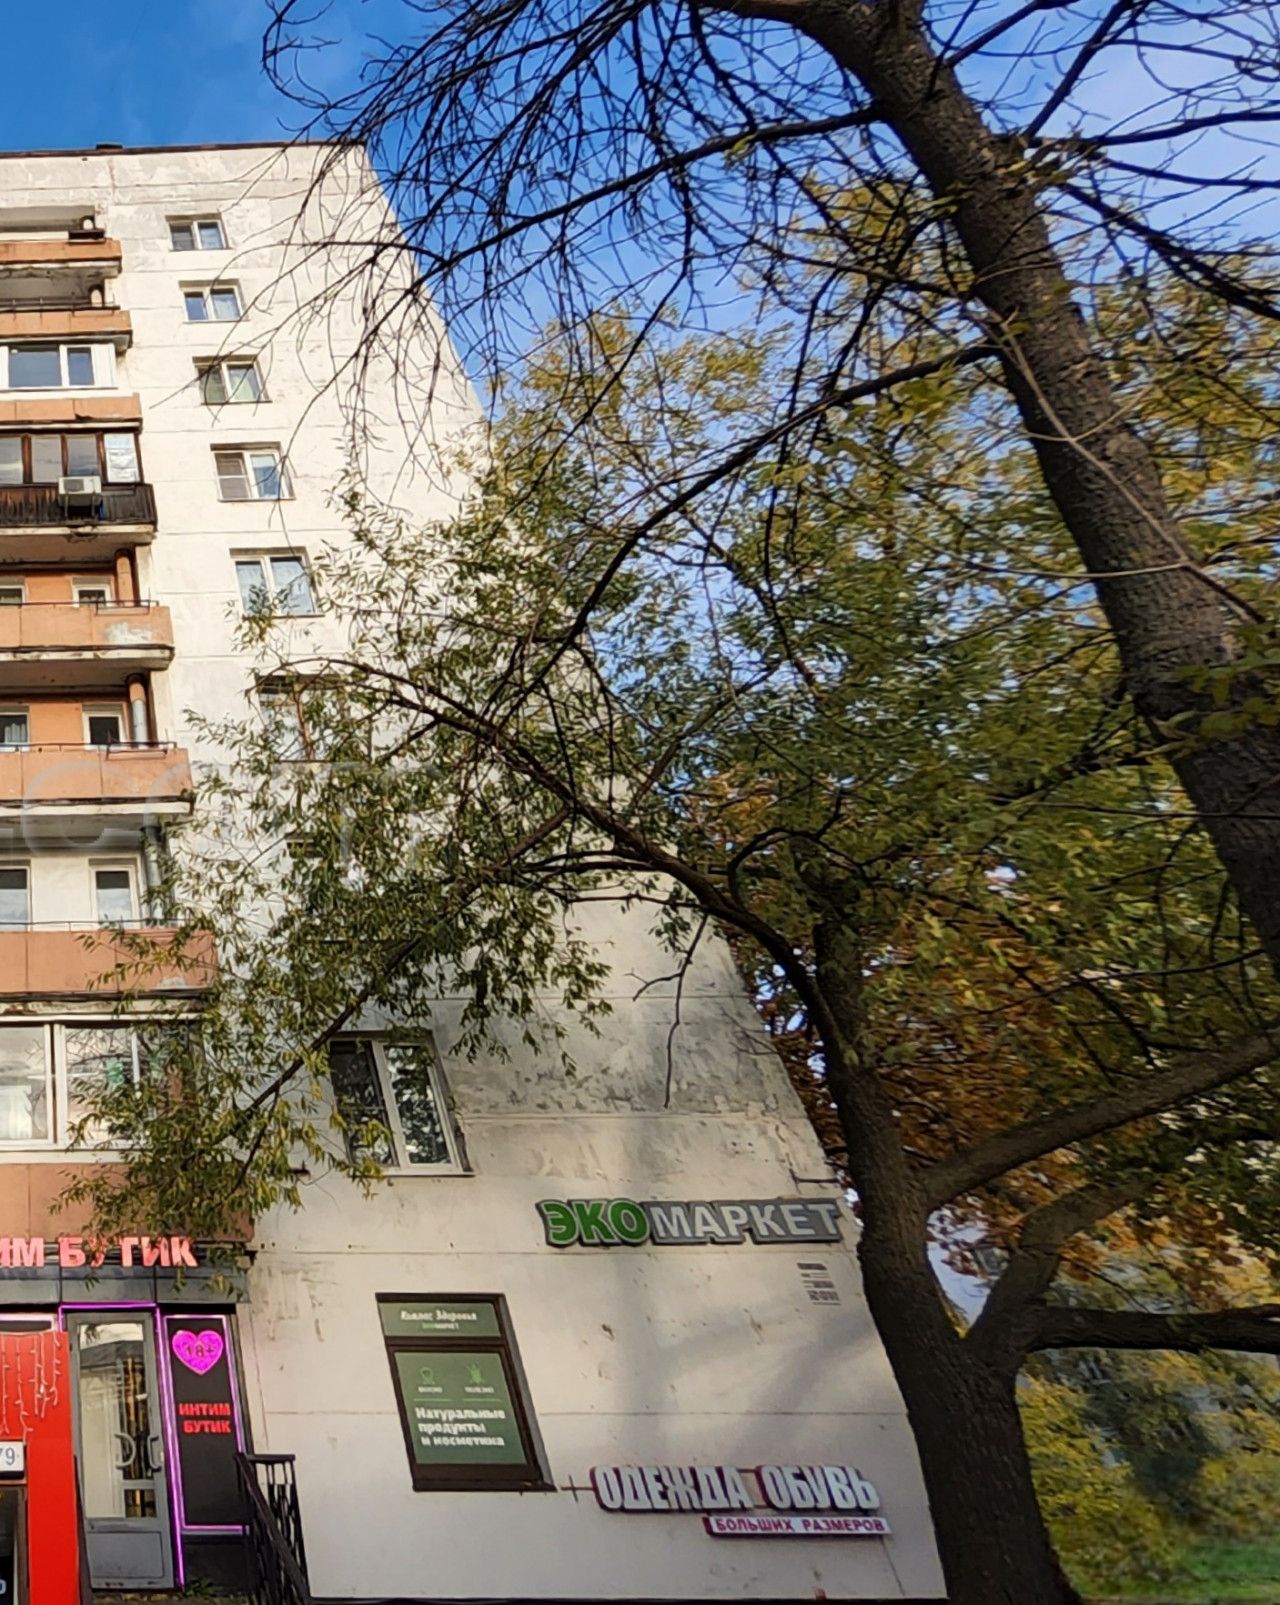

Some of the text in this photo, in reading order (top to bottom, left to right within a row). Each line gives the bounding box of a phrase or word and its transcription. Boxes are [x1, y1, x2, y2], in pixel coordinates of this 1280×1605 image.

[540, 1200, 841, 1244] ЭКОМАРКЕТ
[184, 1343, 215, 1359] 18+
[178, 1403, 232, 1415] ИНТИМ
[415, 1407, 505, 1421] Натуральные
[183, 1420, 232, 1433] БУТИК
[418, 1423, 486, 1435] продукты
[592, 1465, 881, 1512] ОДЕЖДА ОБУВЬ
[715, 1517, 886, 1534] БОЛЬШИХ РАЗМЕРОВ
